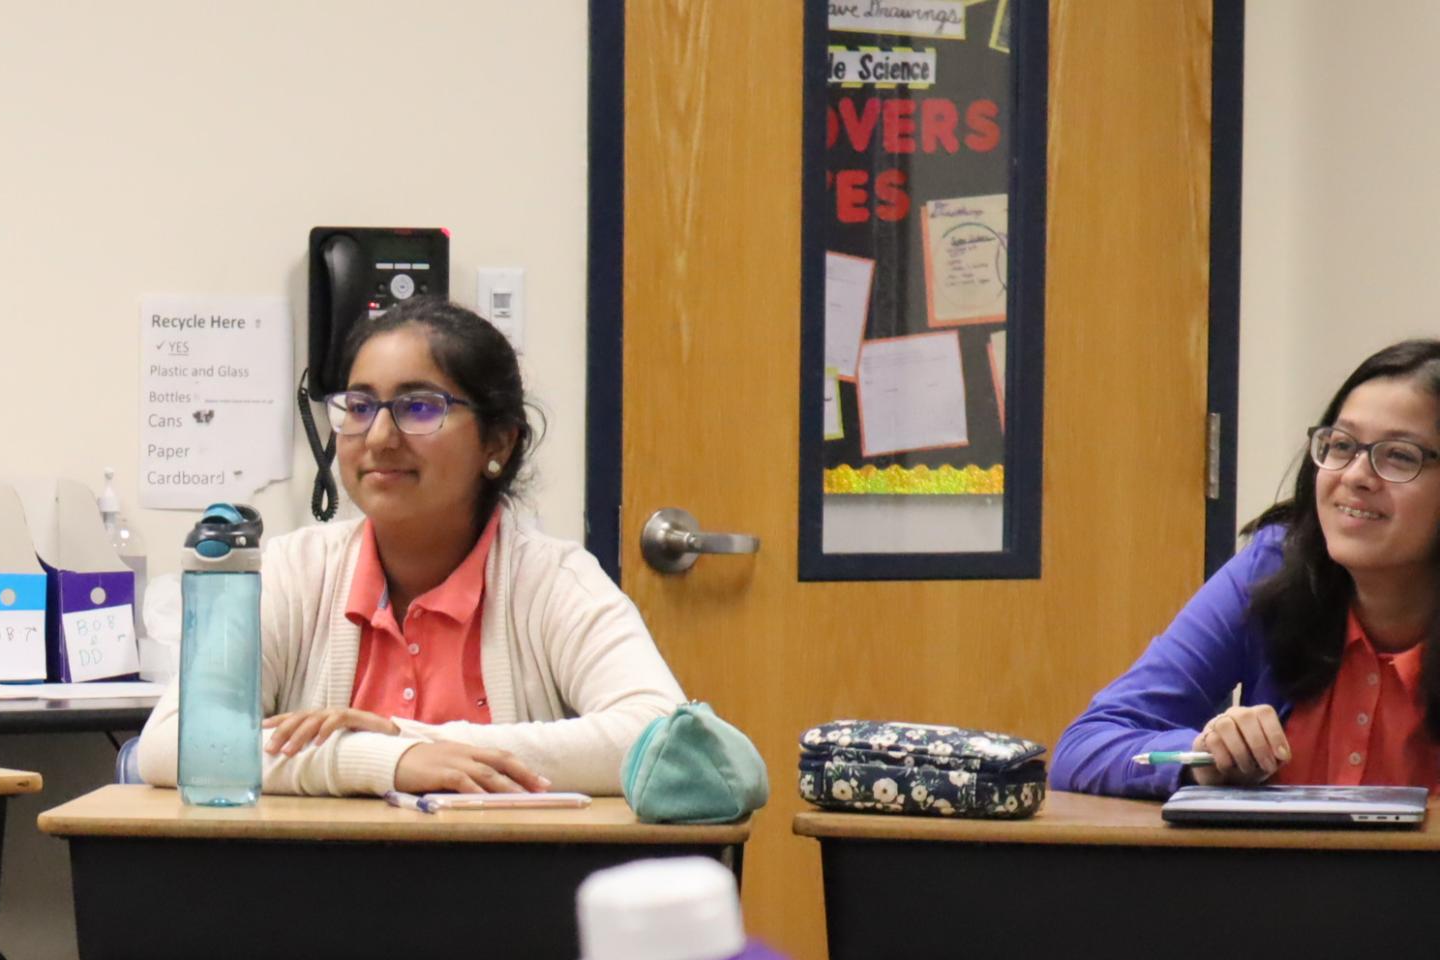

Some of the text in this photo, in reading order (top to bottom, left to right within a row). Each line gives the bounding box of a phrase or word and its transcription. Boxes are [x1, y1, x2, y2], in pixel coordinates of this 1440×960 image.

[858, 53, 929, 81] Science
[826, 168, 912, 224] ES
[151, 314, 246, 331] Recycle Here
[168, 341, 190, 354] YES
[150, 365, 250, 378] Plastic and Glass
[148, 391, 192, 403] Bottles
[147, 413, 183, 428] Cans
[147, 443, 191, 460] Paper
[146, 471, 225, 485] Cardboard
